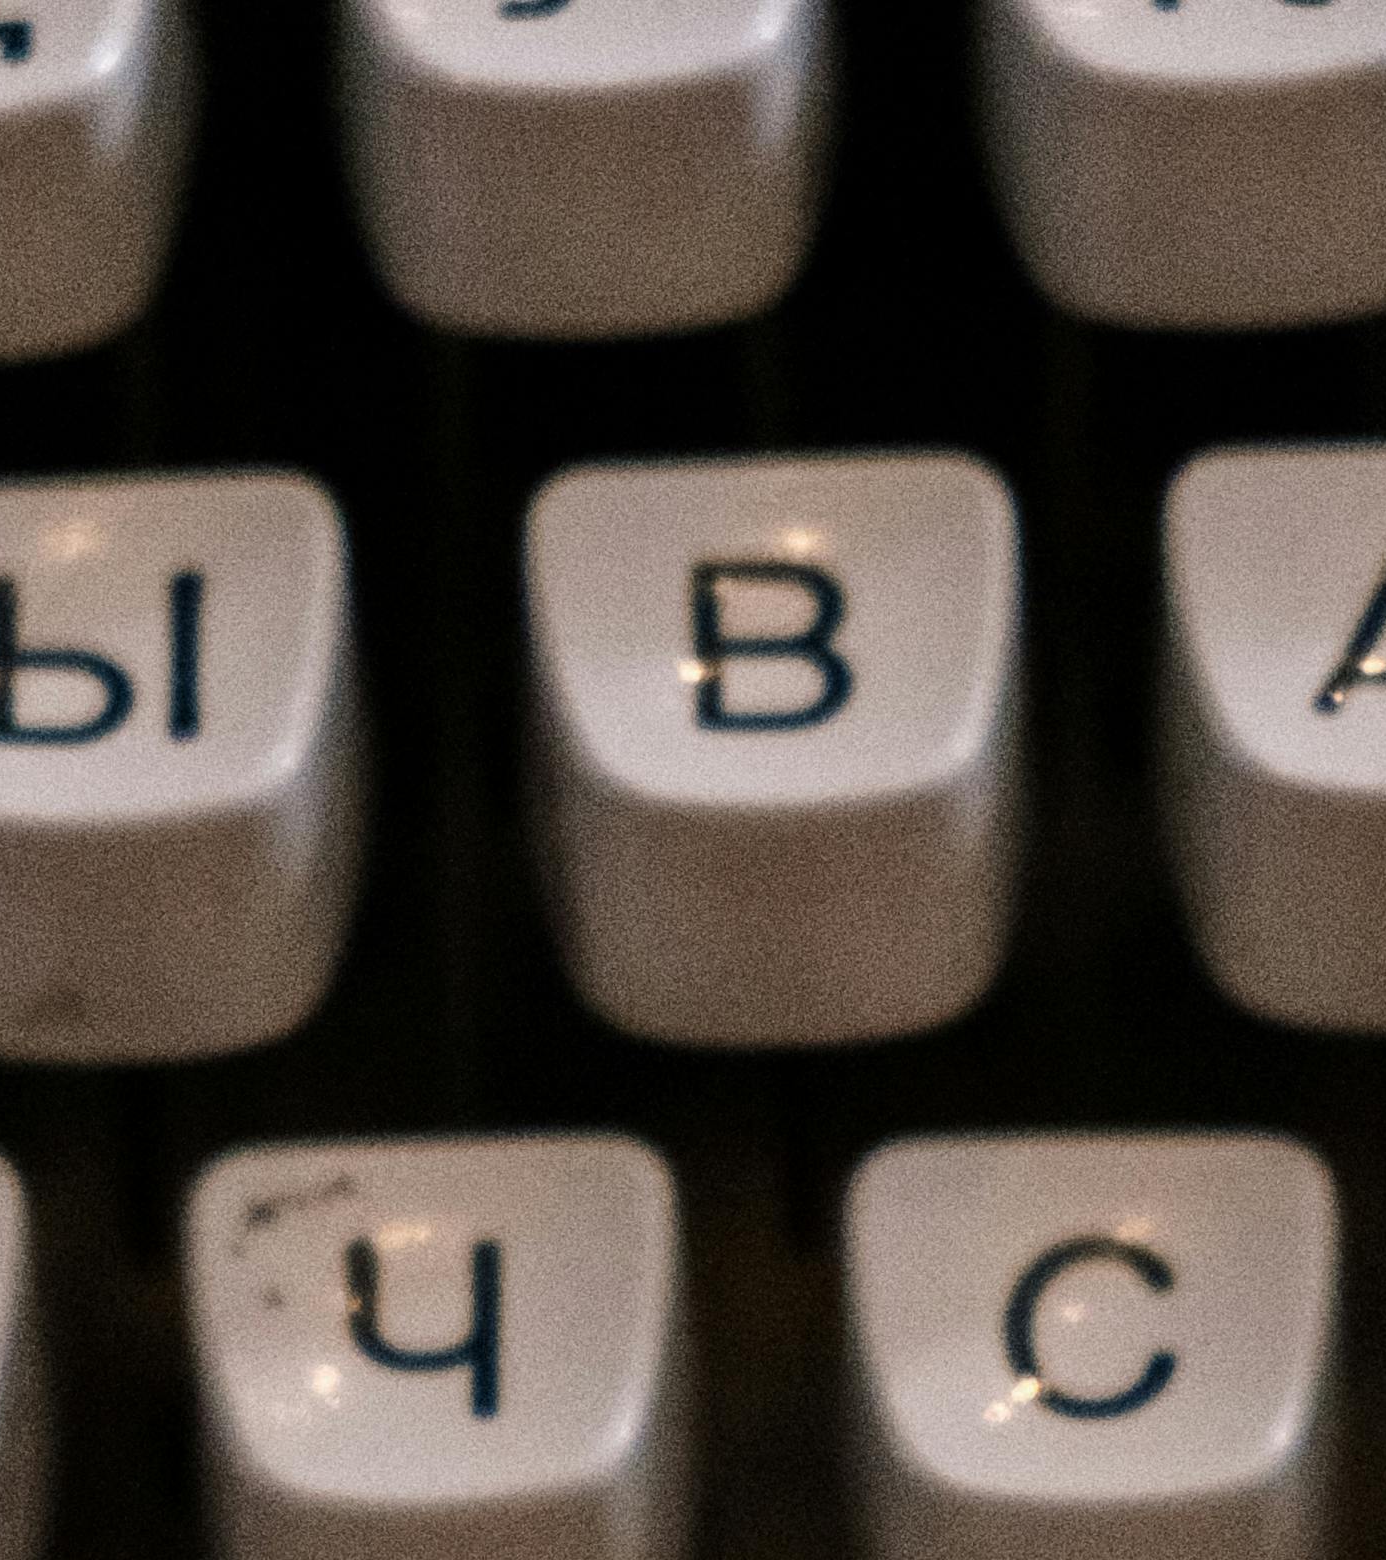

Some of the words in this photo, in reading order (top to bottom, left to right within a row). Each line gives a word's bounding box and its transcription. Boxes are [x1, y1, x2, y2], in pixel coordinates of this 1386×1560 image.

[687, 559, 855, 732] В
[344, 1238, 503, 1419] Ч
[1001, 1235, 1178, 1420] С
